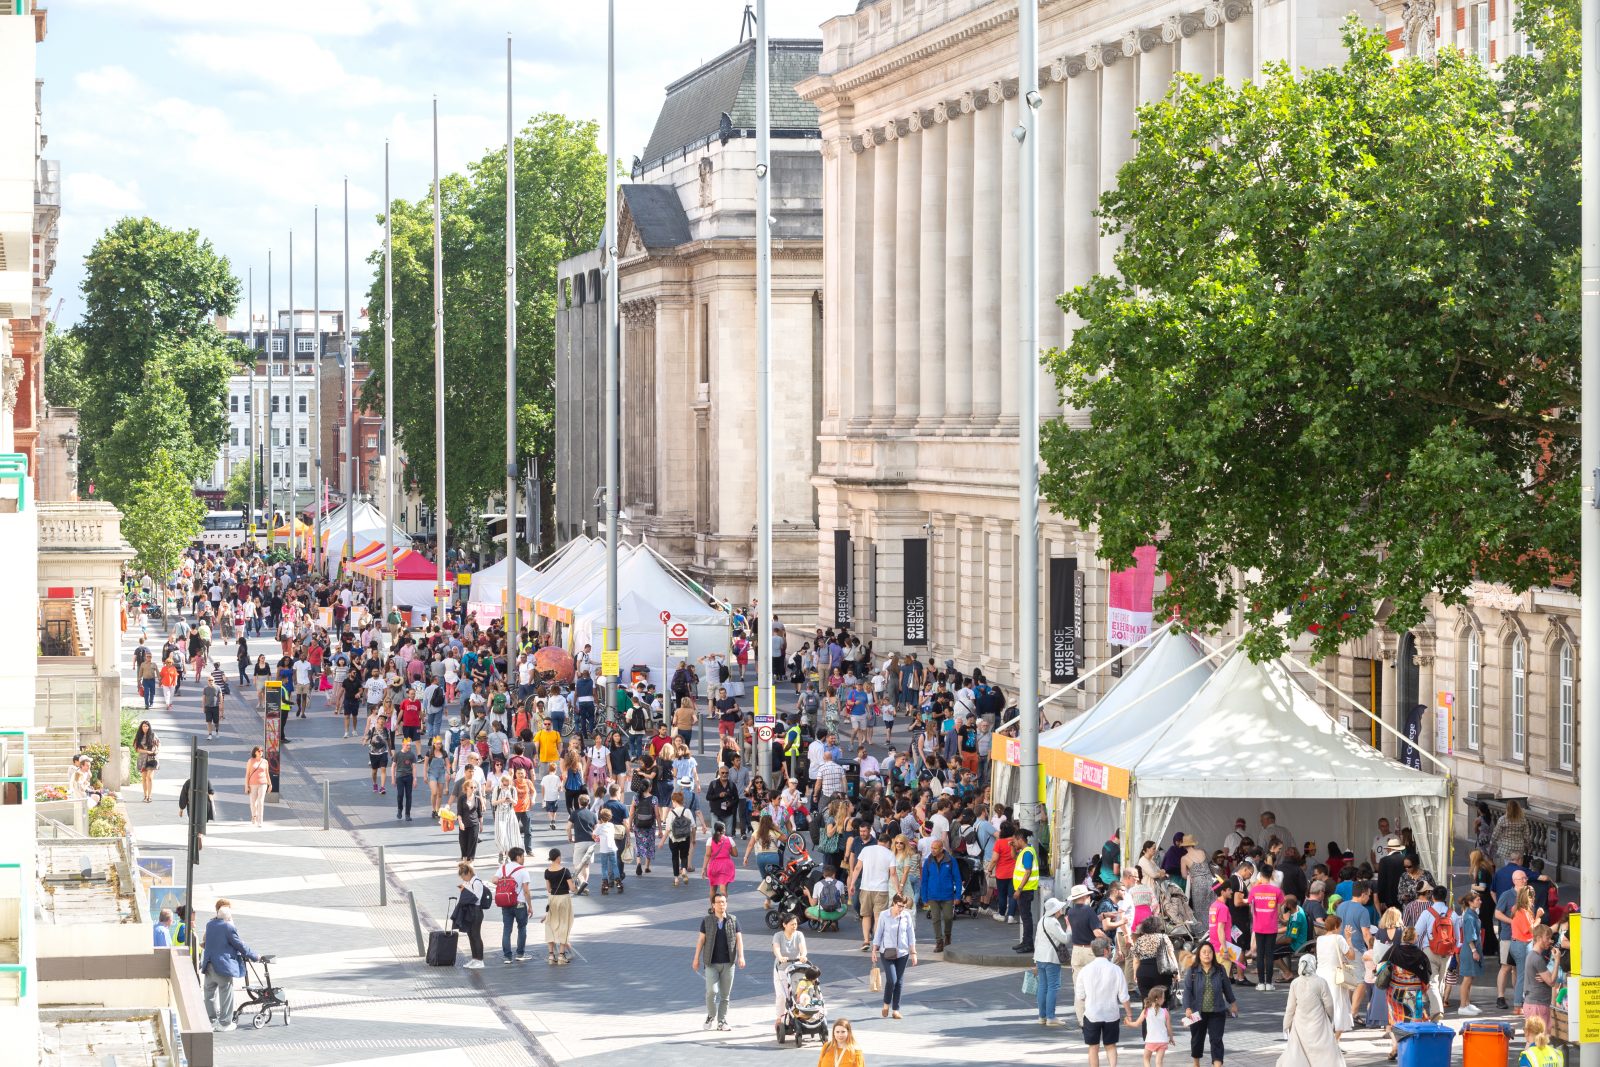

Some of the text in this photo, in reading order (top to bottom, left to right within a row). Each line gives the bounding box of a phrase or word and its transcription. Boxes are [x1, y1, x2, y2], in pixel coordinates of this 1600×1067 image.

[661, 612, 668, 621] K
[838, 586, 846, 622] SCIENCE
[907, 599, 915, 639] SCIENCE
[916, 596, 924, 639] MUSEUM
[1054, 629, 1064, 676] SCIENCE
[1064, 626, 1074, 676] MUSEUM
[1406, 723, 1417, 755] Coege
